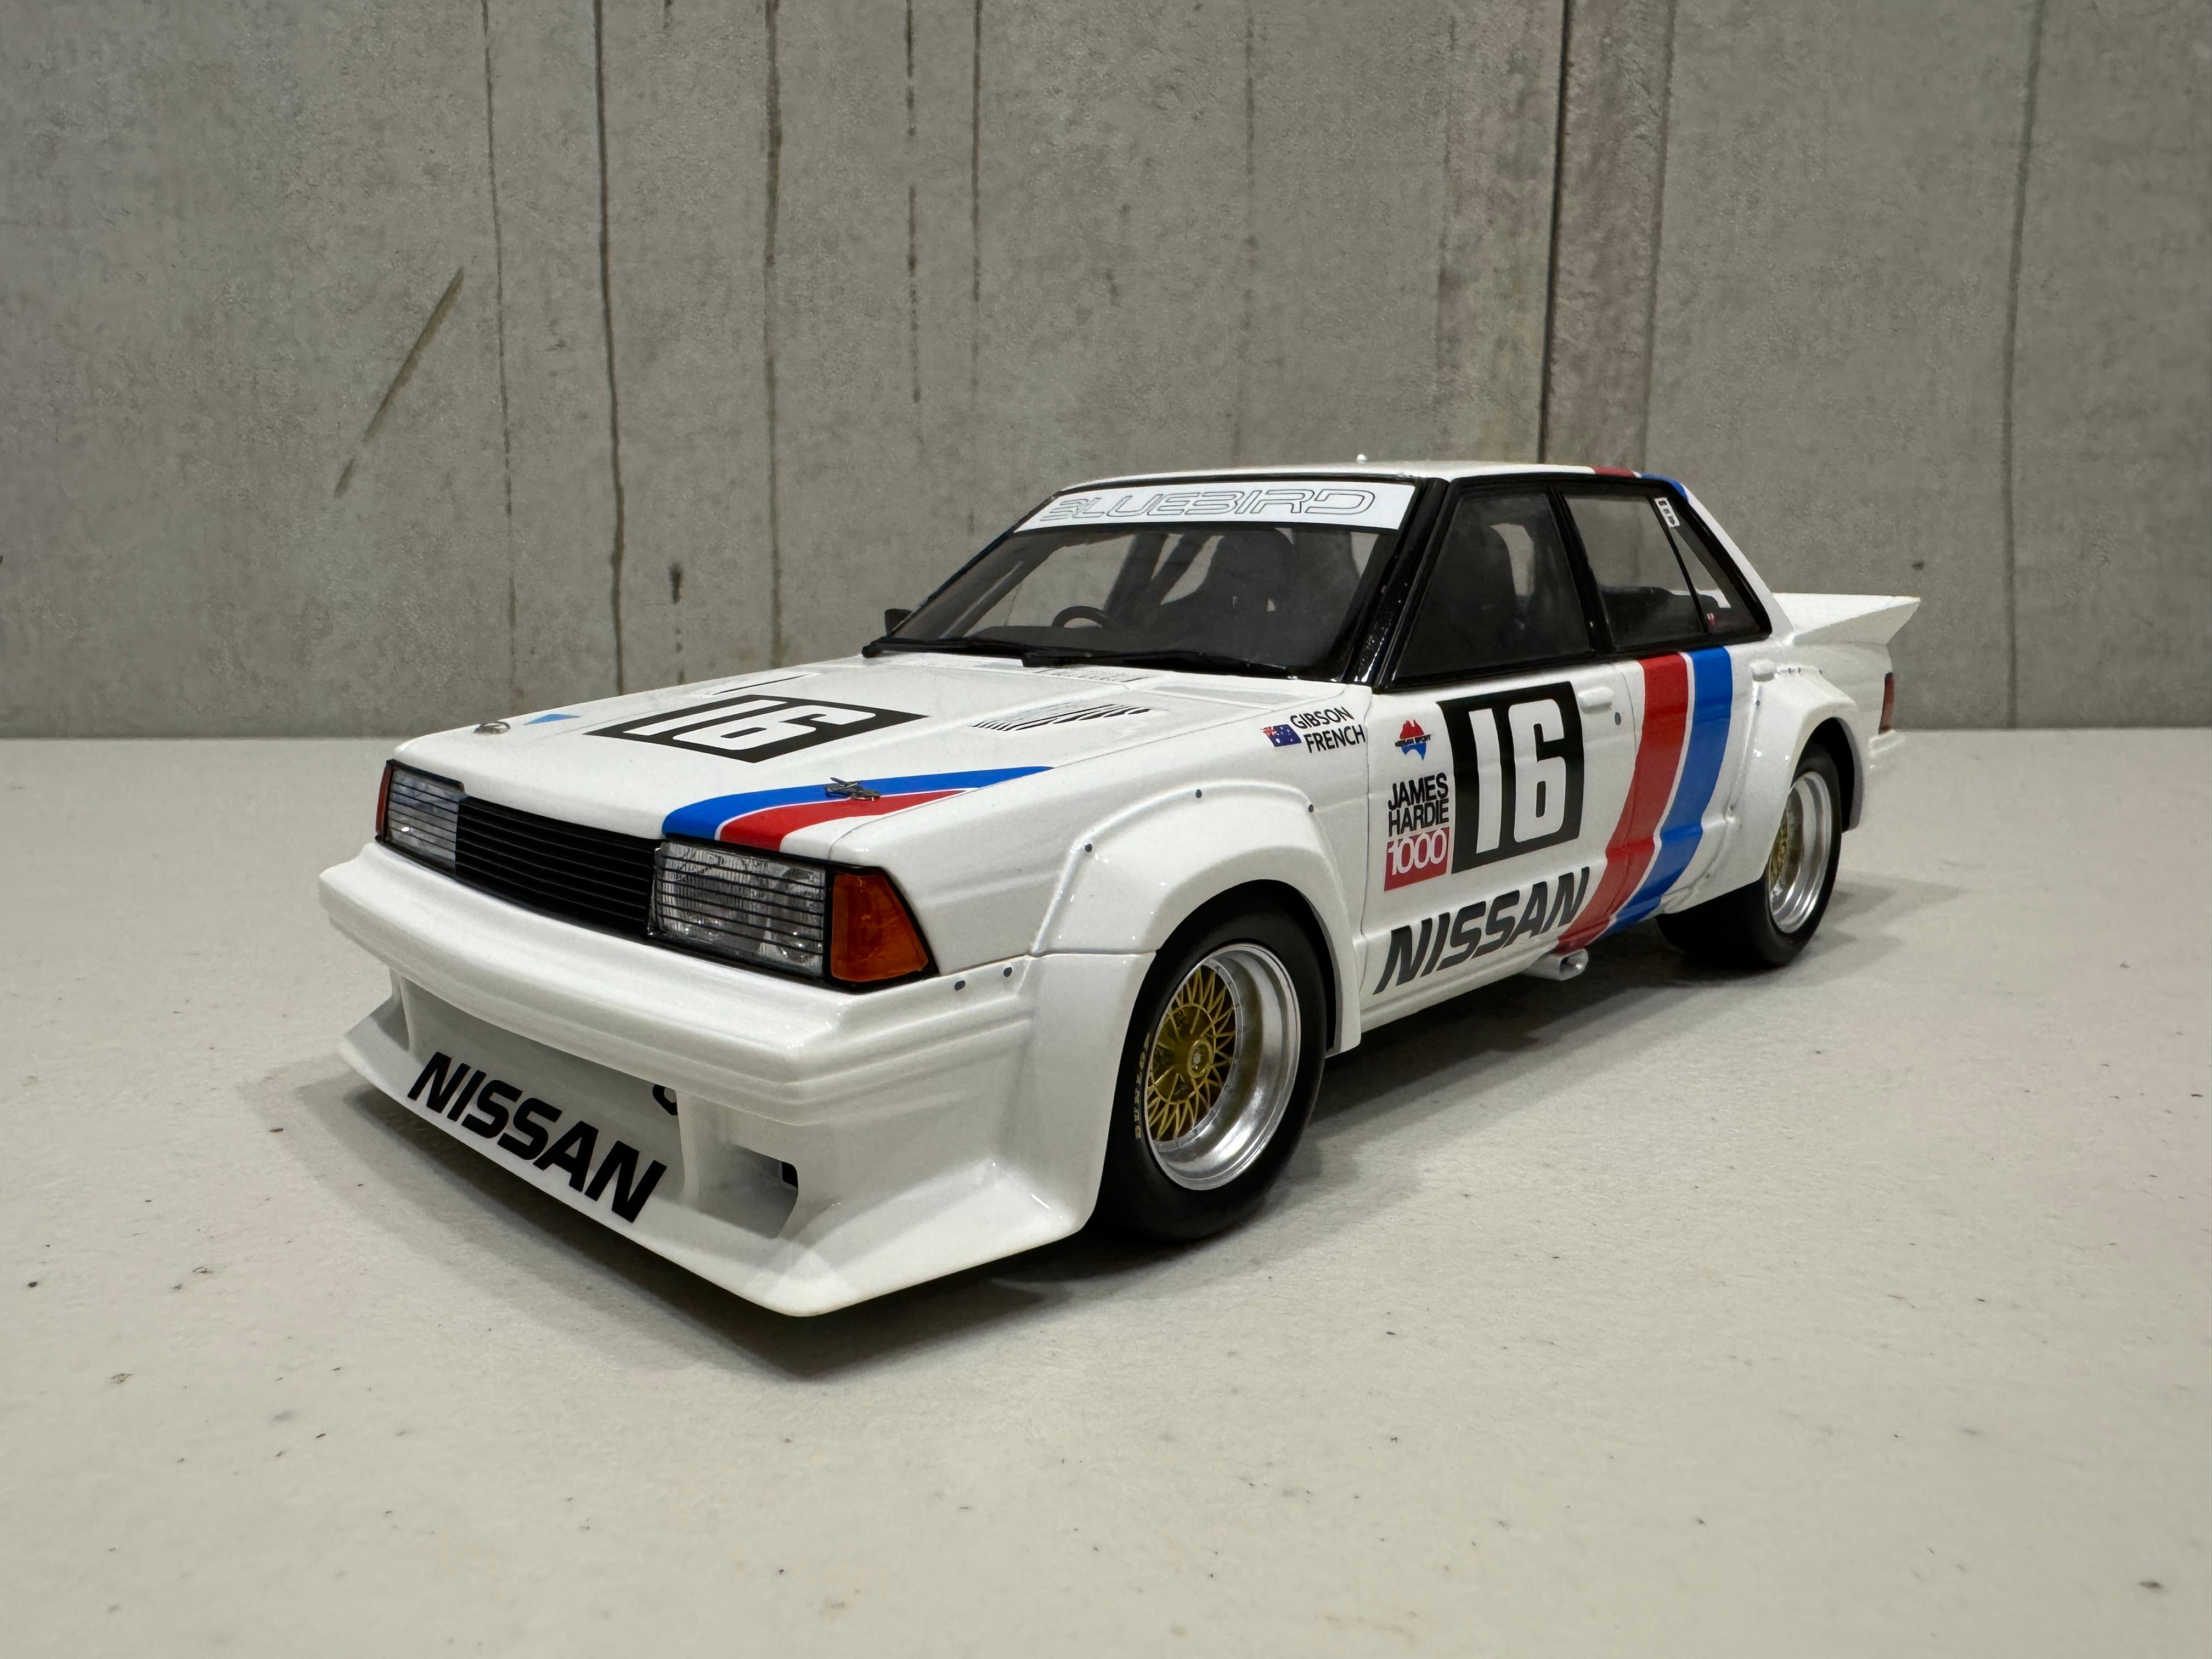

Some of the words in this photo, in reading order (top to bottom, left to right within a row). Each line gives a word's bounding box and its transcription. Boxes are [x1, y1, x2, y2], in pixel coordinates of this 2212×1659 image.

[1040, 489, 1375, 521] BLUEBIRD
[622, 699, 877, 751] 16
[1290, 706, 1355, 729] GIBSON
[1303, 724, 1366, 753] FRENCH
[1387, 772, 1449, 811] JAMES
[1468, 698, 1566, 854] 16
[1388, 798, 1449, 837] HARDIE
[1387, 828, 1447, 876] 1000
[1372, 866, 1590, 995] NISSAN
[407, 1051, 668, 1223] NISSAN
